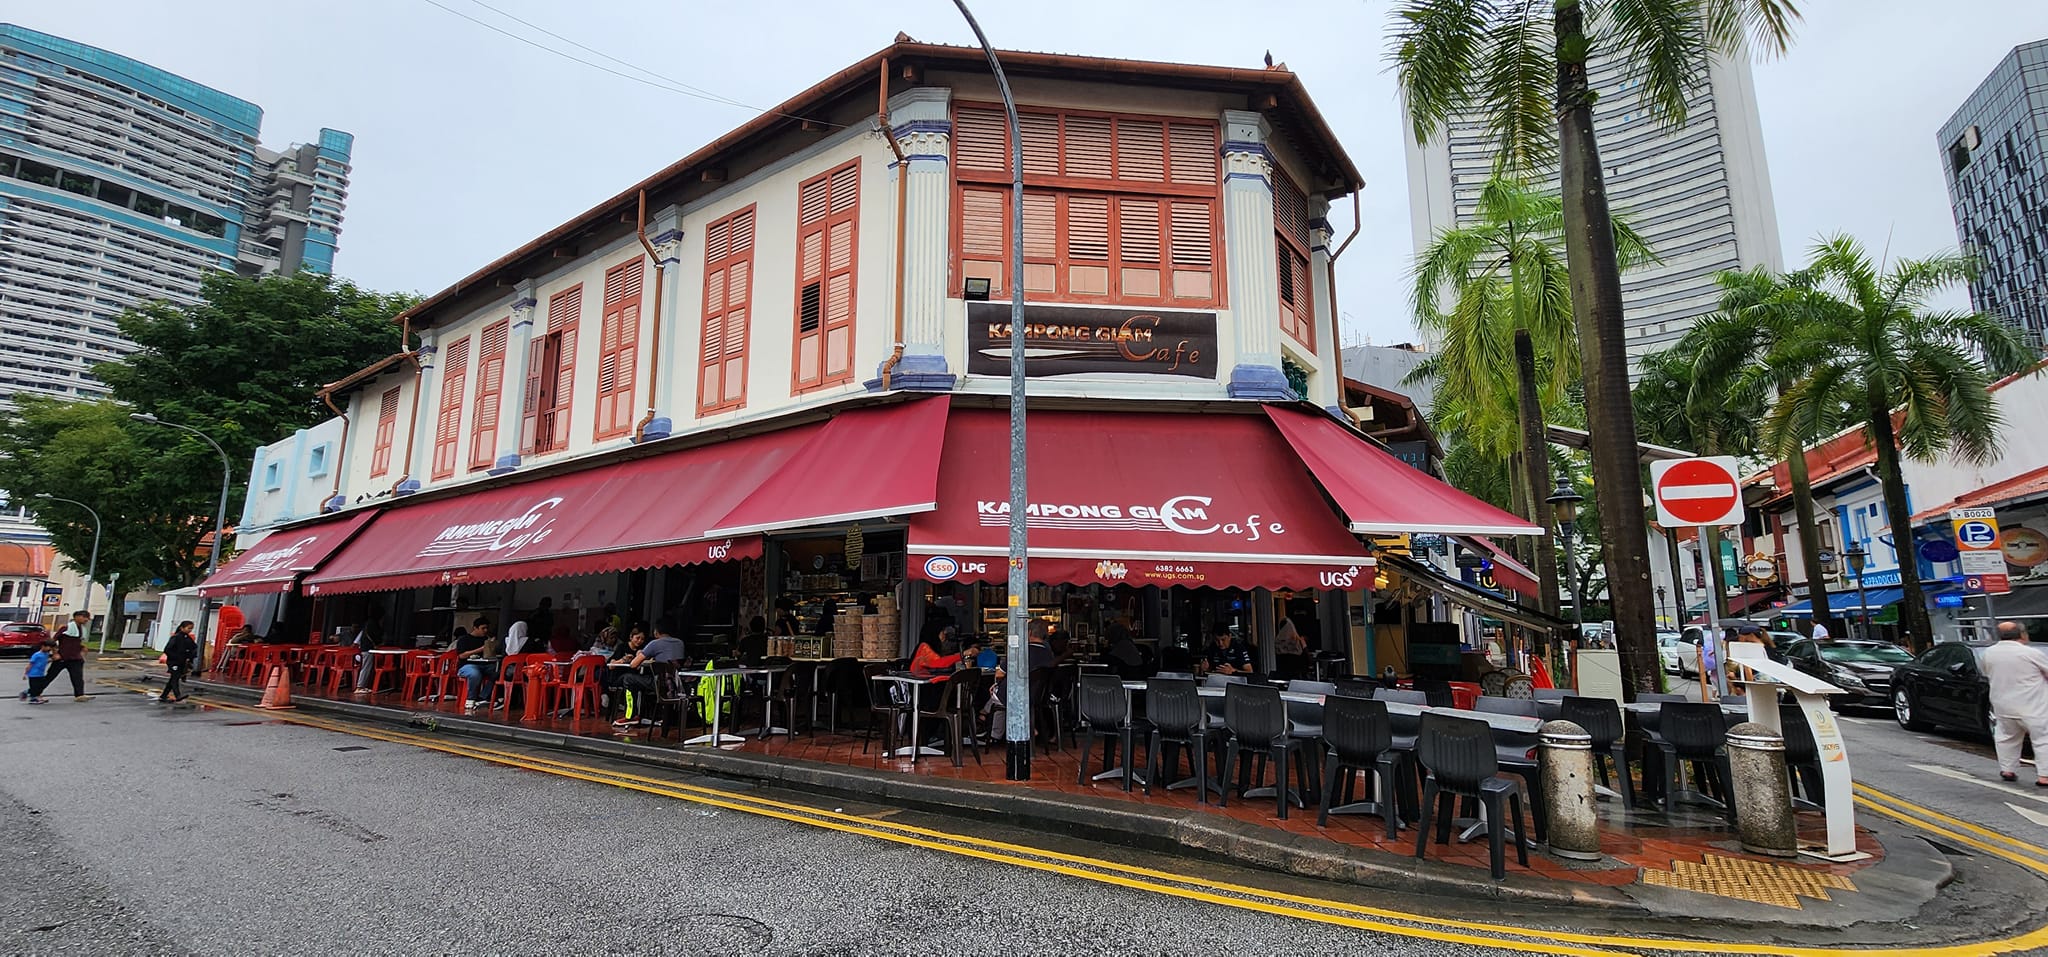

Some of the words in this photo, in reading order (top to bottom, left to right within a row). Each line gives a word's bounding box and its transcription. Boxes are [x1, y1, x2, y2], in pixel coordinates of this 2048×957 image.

[1117, 314, 1201, 371] Cafe
[977, 501, 1122, 519] KAMPONG
[1128, 505, 1208, 521] GLAM
[1964, 510, 1992, 518] B0020
[1160, 495, 1286, 541] Cafe
[708, 545, 727, 559] UGS
[961, 562, 986, 574] LPG
[1175, 565, 1194, 573] 6663
[1144, 572, 1205, 581] www.ugs.com.sg
[1320, 571, 1353, 587] UGS
